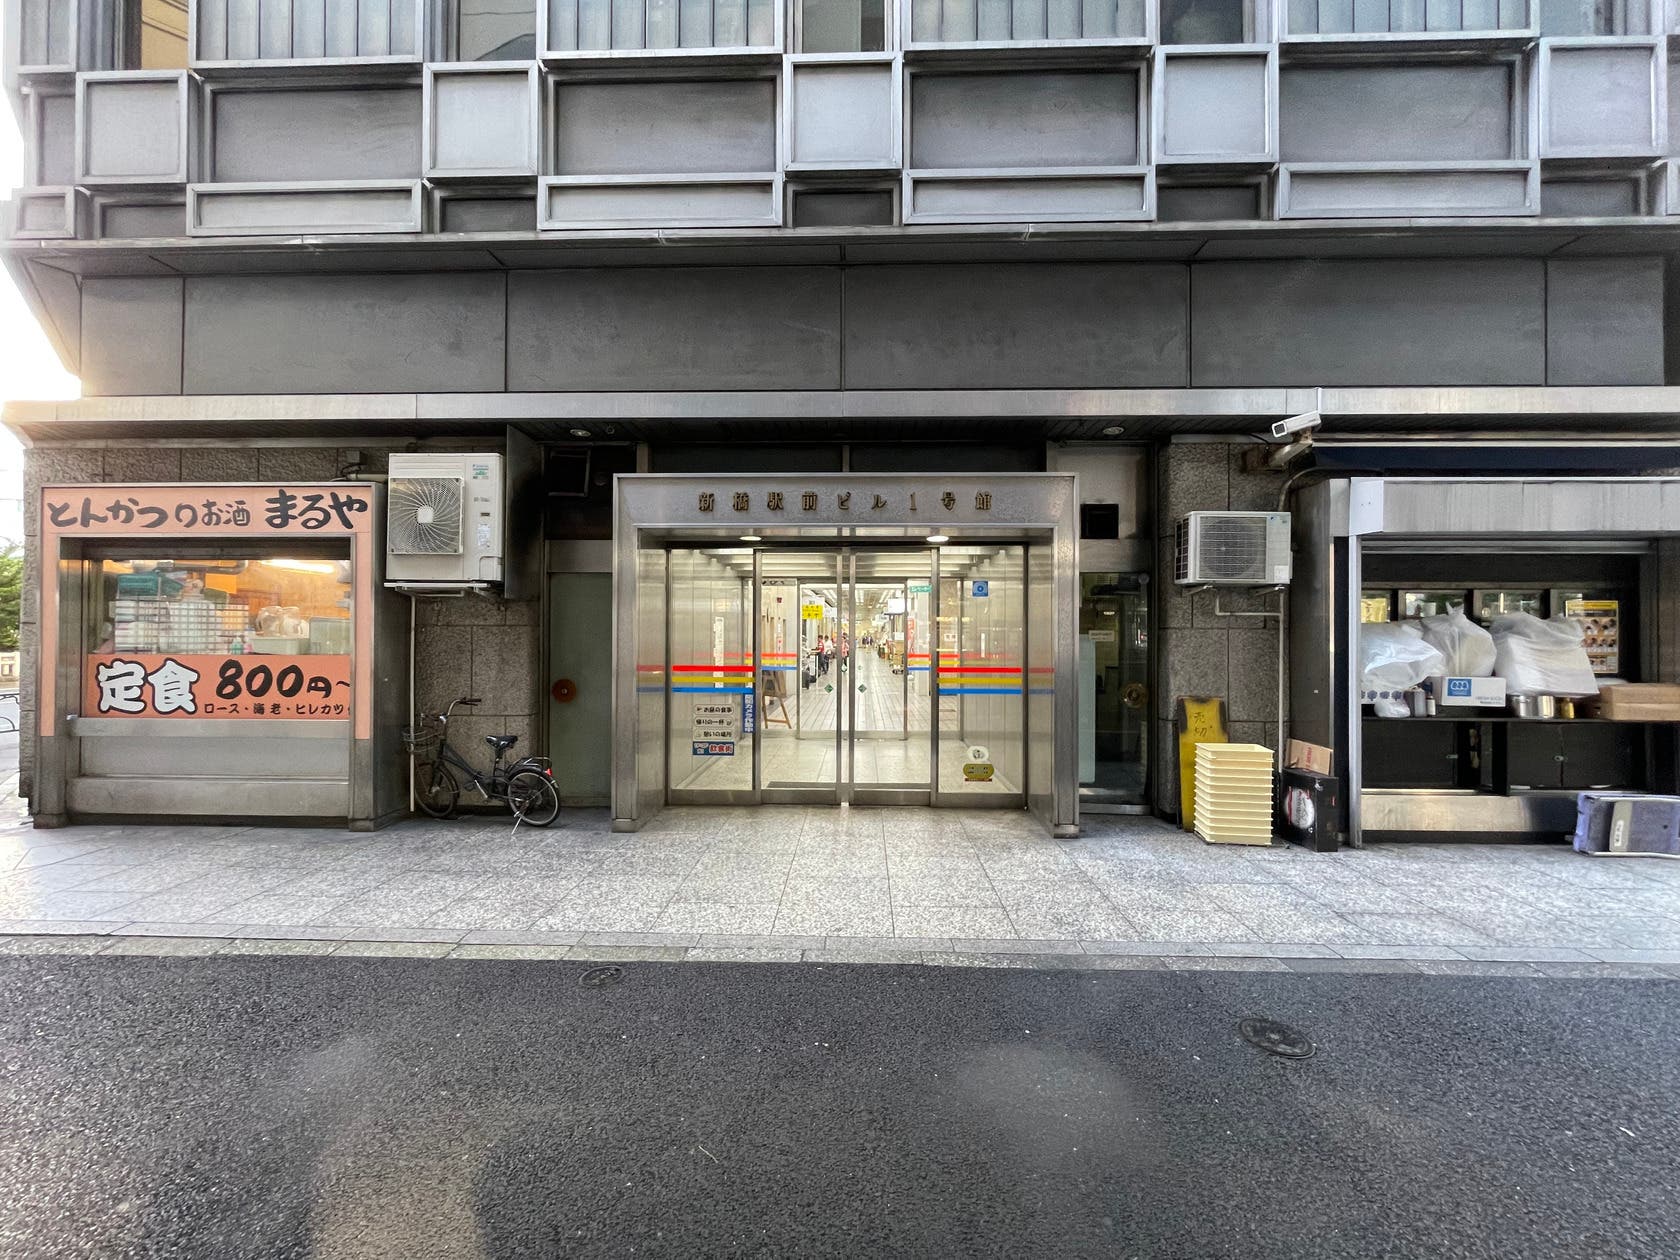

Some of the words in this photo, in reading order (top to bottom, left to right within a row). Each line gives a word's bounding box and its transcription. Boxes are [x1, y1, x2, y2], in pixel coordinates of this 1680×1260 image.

[264, 488, 368, 530] まるや
[698, 492, 993, 513] 新橋駅前ビル1号館
[95, 657, 201, 715] 定食
